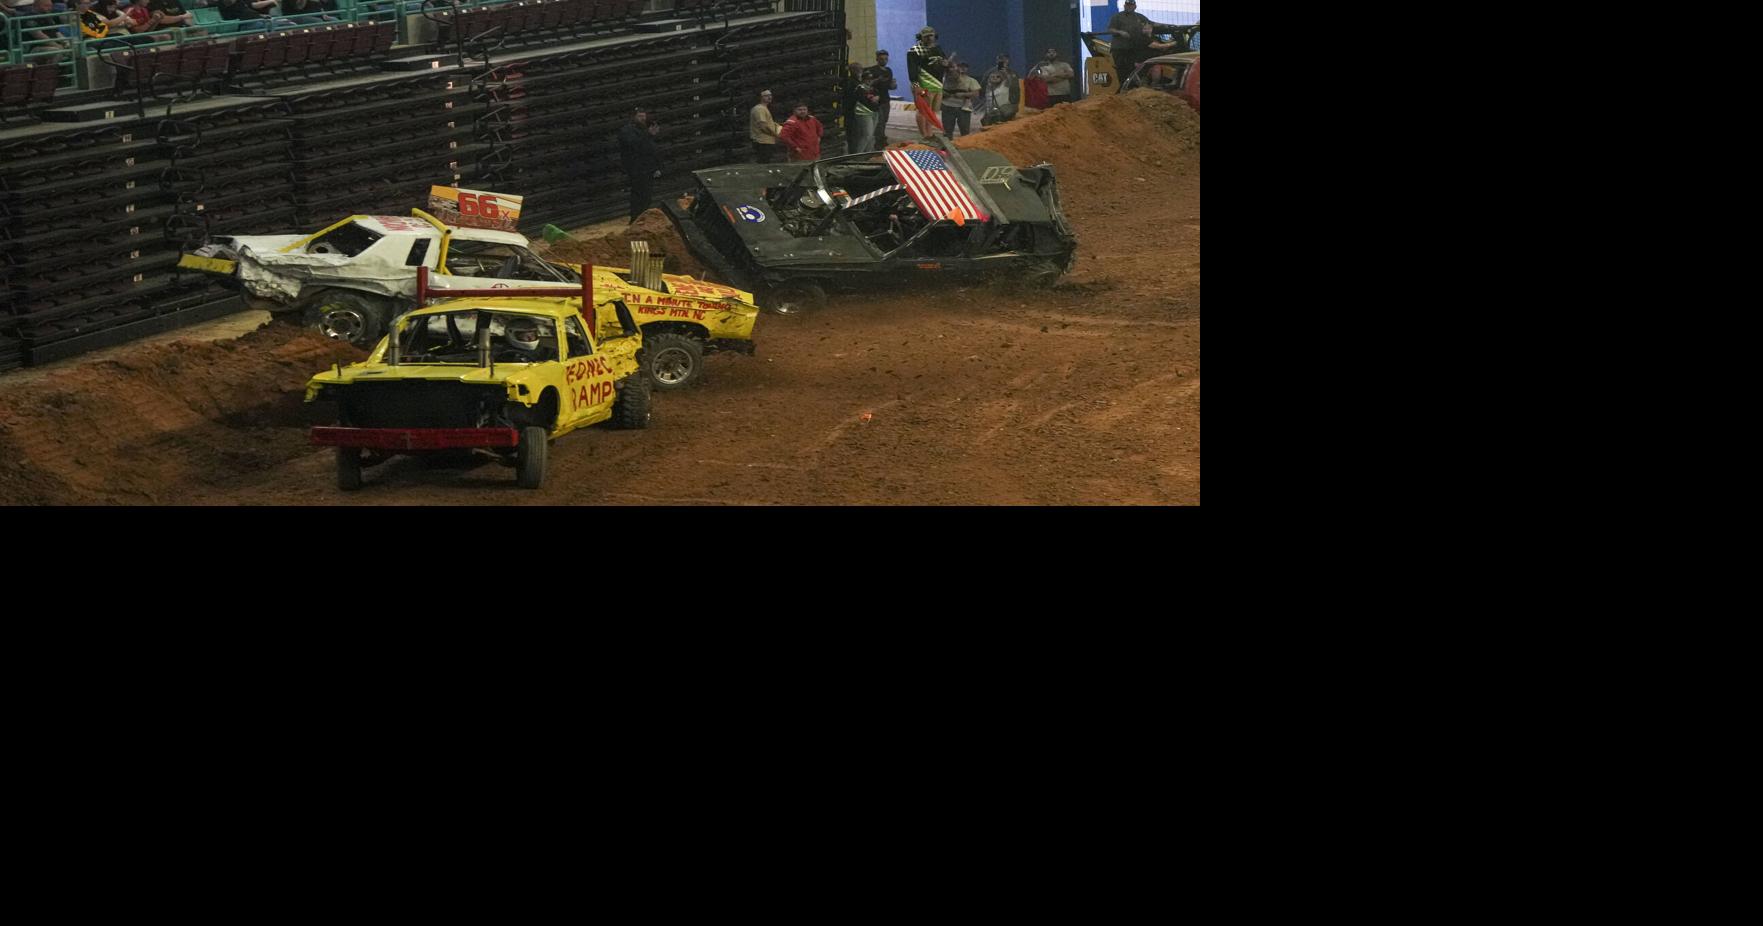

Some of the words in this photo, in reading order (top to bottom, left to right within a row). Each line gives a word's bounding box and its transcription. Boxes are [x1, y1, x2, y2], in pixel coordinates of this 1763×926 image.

[1092, 72, 1108, 84] CAT
[645, 296, 653, 304] A
[657, 297, 693, 307] MINUTE
